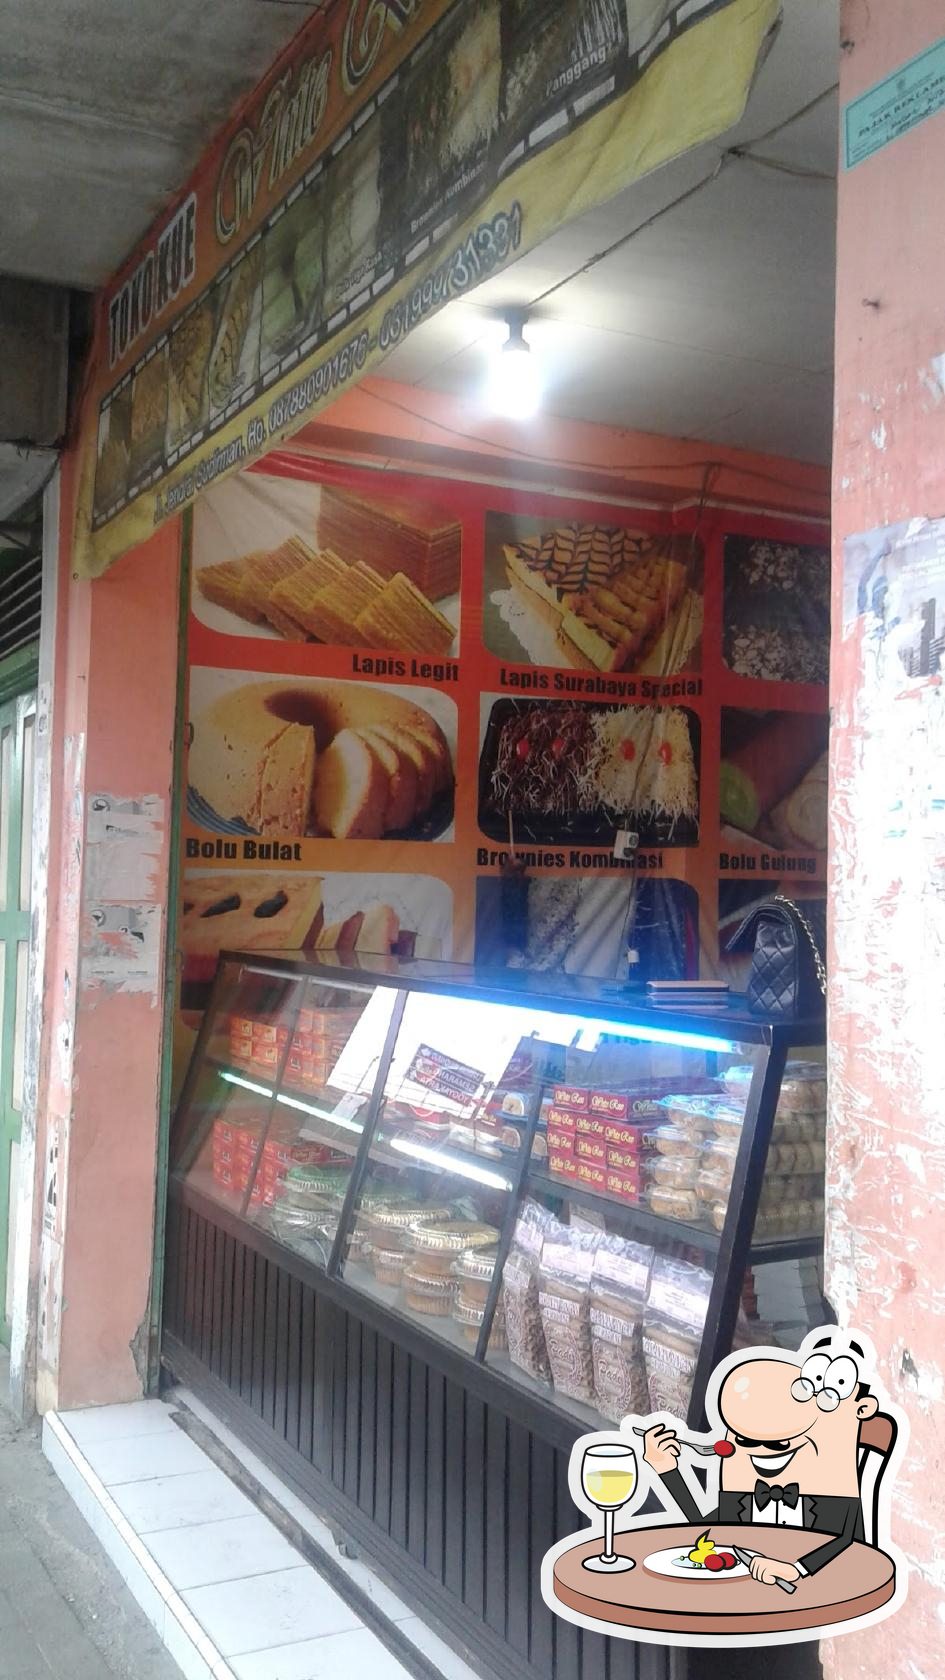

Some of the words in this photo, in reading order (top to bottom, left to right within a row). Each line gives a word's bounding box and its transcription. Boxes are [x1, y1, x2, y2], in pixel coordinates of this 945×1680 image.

[109, 250, 155, 372] TOKO
[155, 191, 197, 320] KUE
[352, 654, 406, 677] Lapis
[411, 659, 459, 681] Legit
[500, 668, 549, 689] Lapis
[553, 673, 637, 698] Surabaya
[641, 678, 704, 699] Special
[186, 838, 237, 859] Bolu
[243, 840, 303, 861] Bulat
[719, 853, 756, 870] Bolu
[760, 854, 817, 874] Gulung
